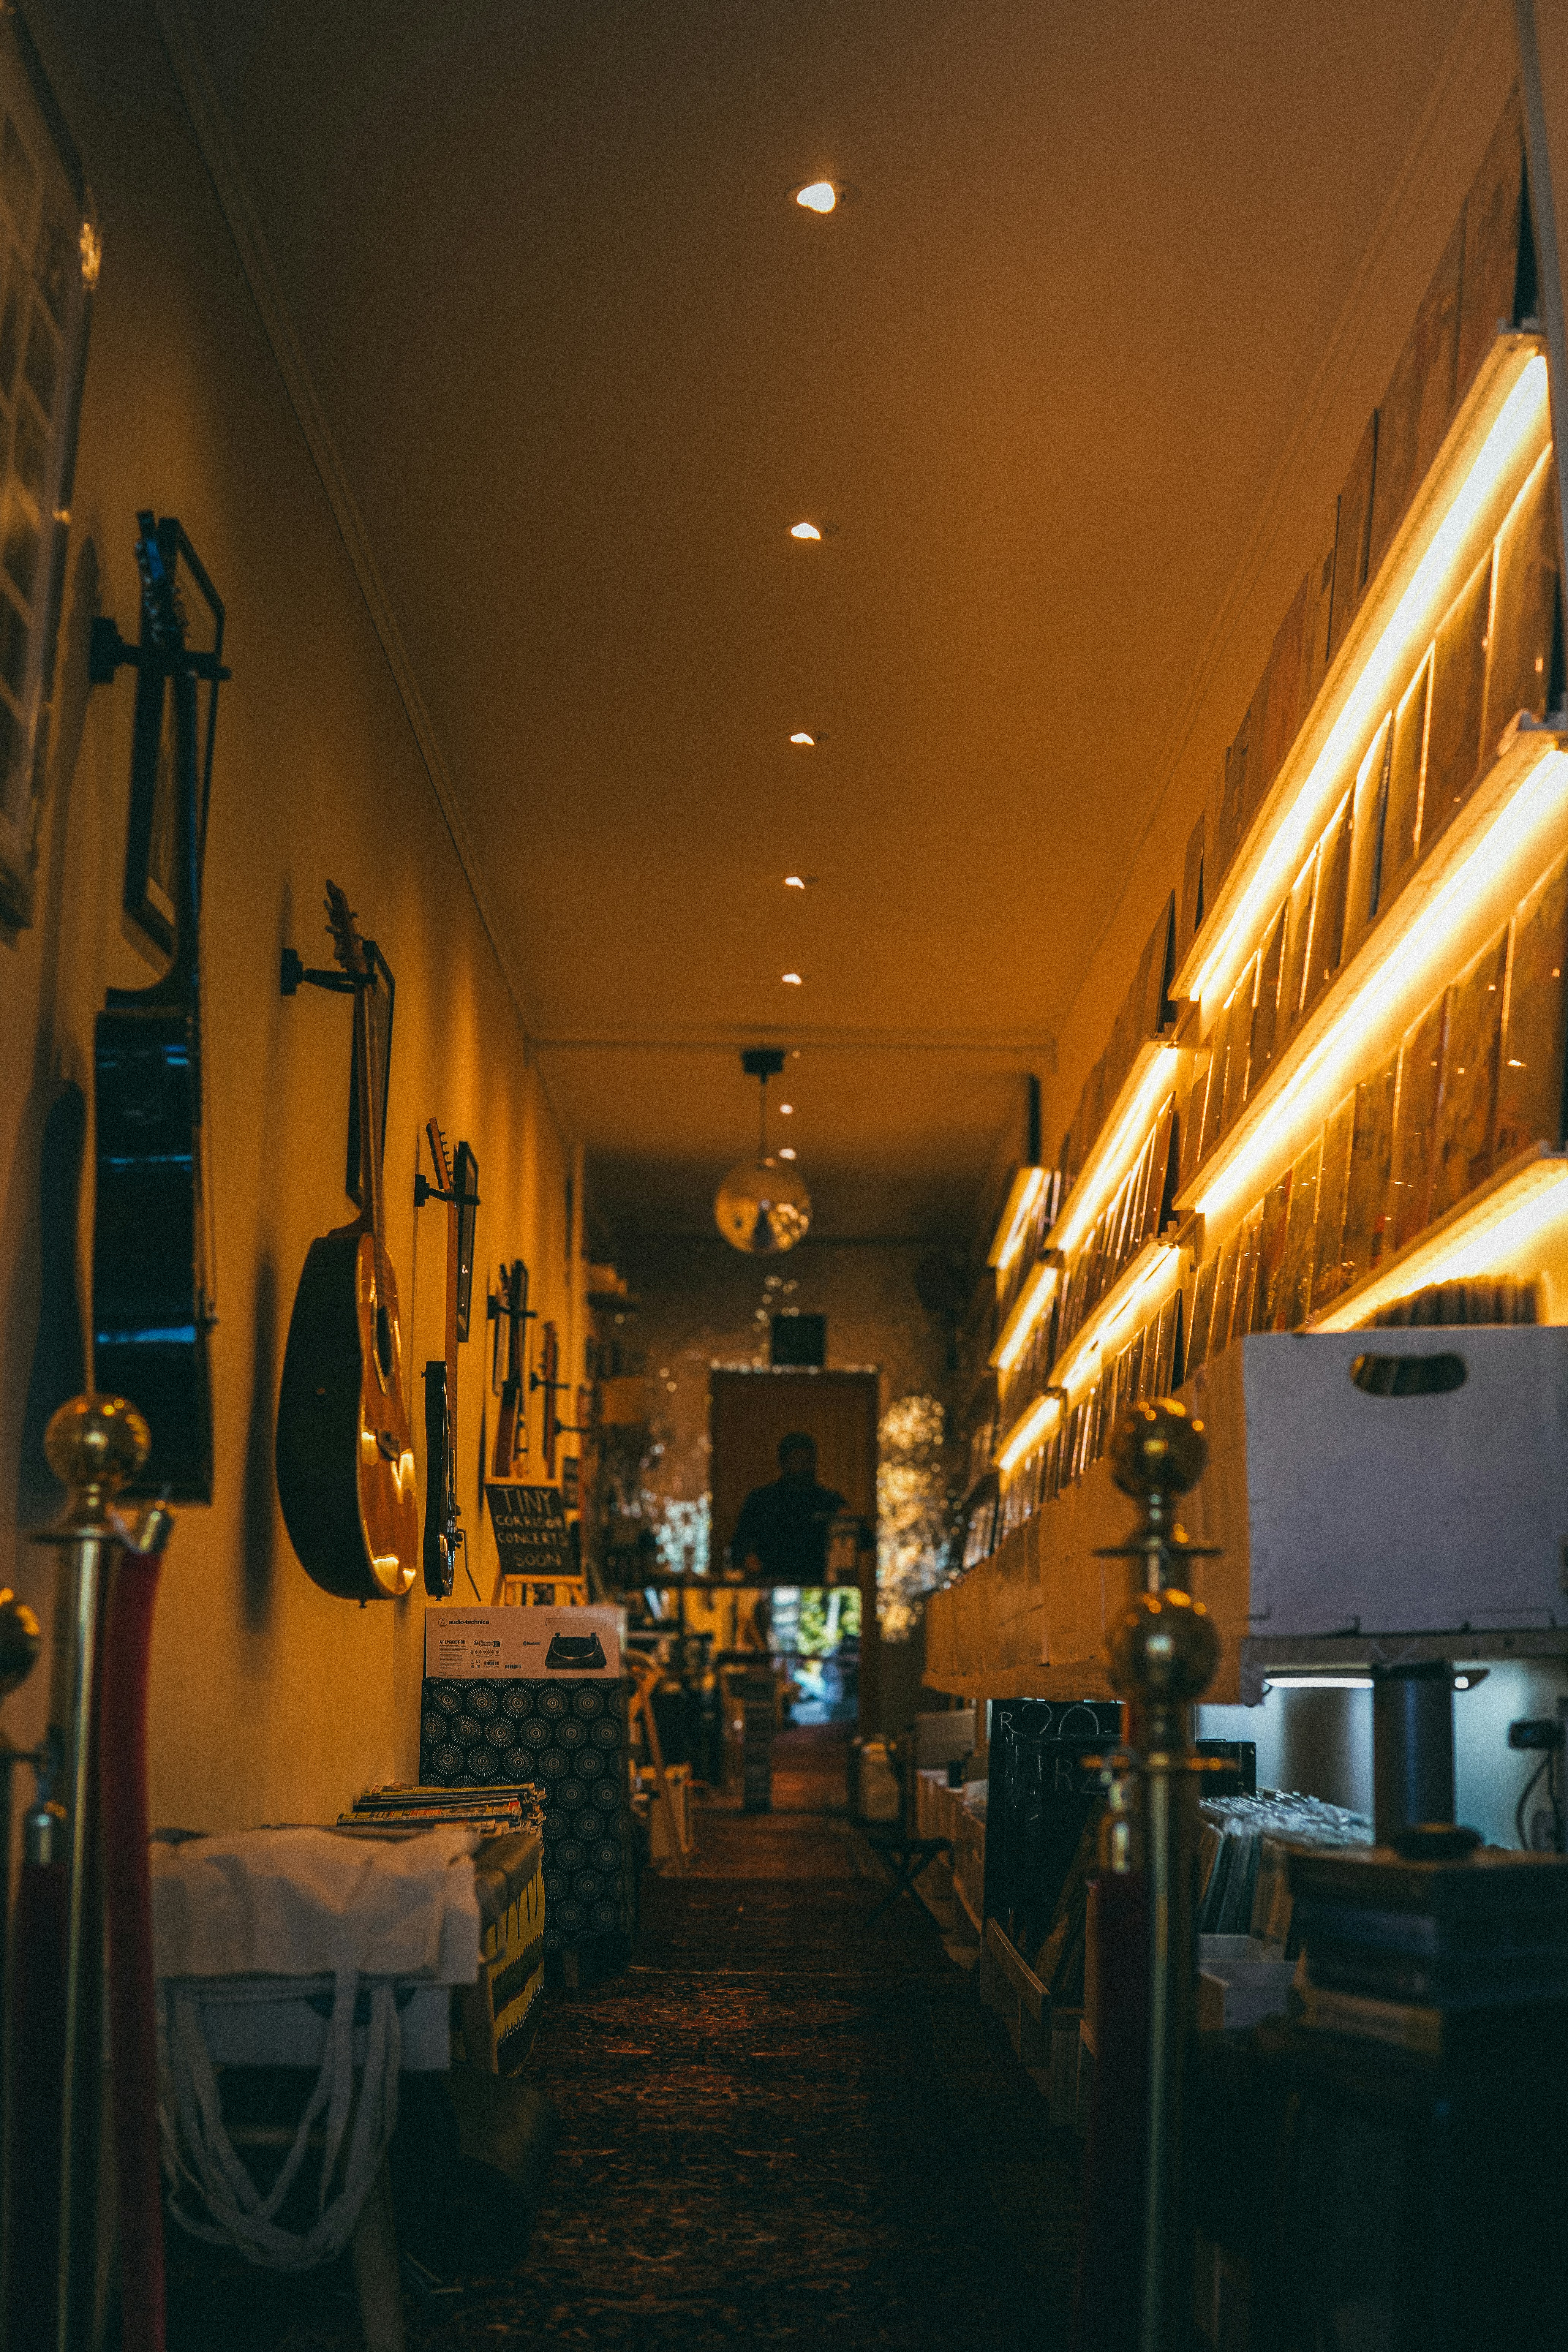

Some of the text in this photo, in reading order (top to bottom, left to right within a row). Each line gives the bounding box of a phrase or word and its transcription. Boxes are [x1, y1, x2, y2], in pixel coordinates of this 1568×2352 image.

[496, 1487, 551, 1516] TINY
[495, 1514, 563, 1529] CORRIDOR
[497, 1532, 569, 1547] CONCERTS
[514, 1552, 562, 1567] SOON
